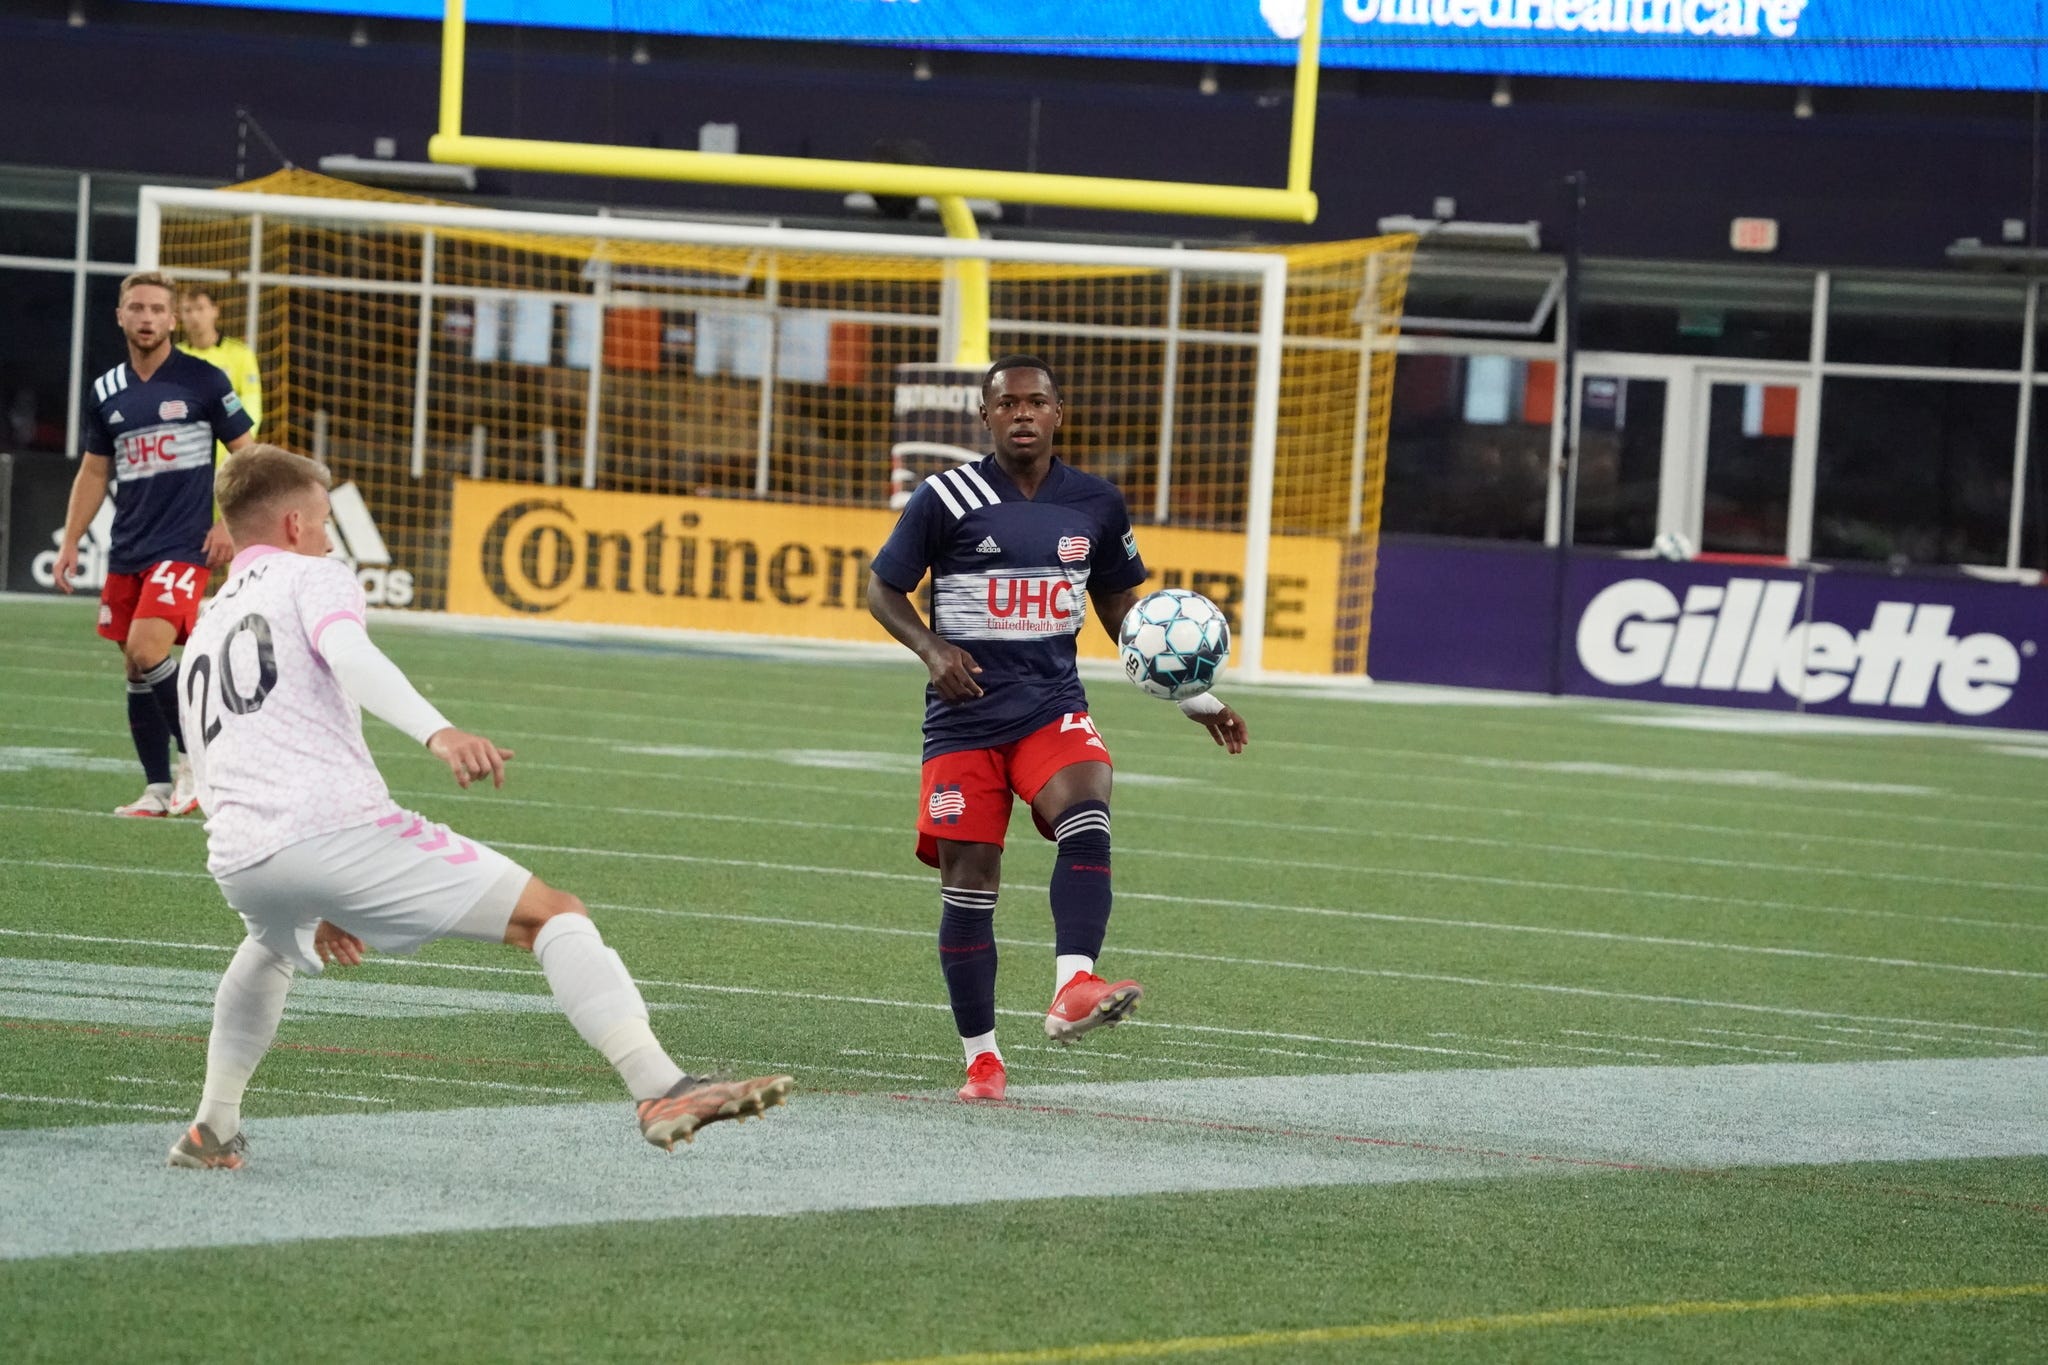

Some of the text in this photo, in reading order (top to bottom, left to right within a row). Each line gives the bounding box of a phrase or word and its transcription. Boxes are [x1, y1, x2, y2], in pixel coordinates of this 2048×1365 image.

[124, 434, 177, 465] UHC
[481, 498, 873, 614] Continen
[150, 560, 197, 600] 44
[987, 577, 1073, 620] UHC
[987, 617, 1068, 633] UnitedHealthare
[1576, 577, 2022, 716] Gillette
[187, 612, 279, 751] 20
